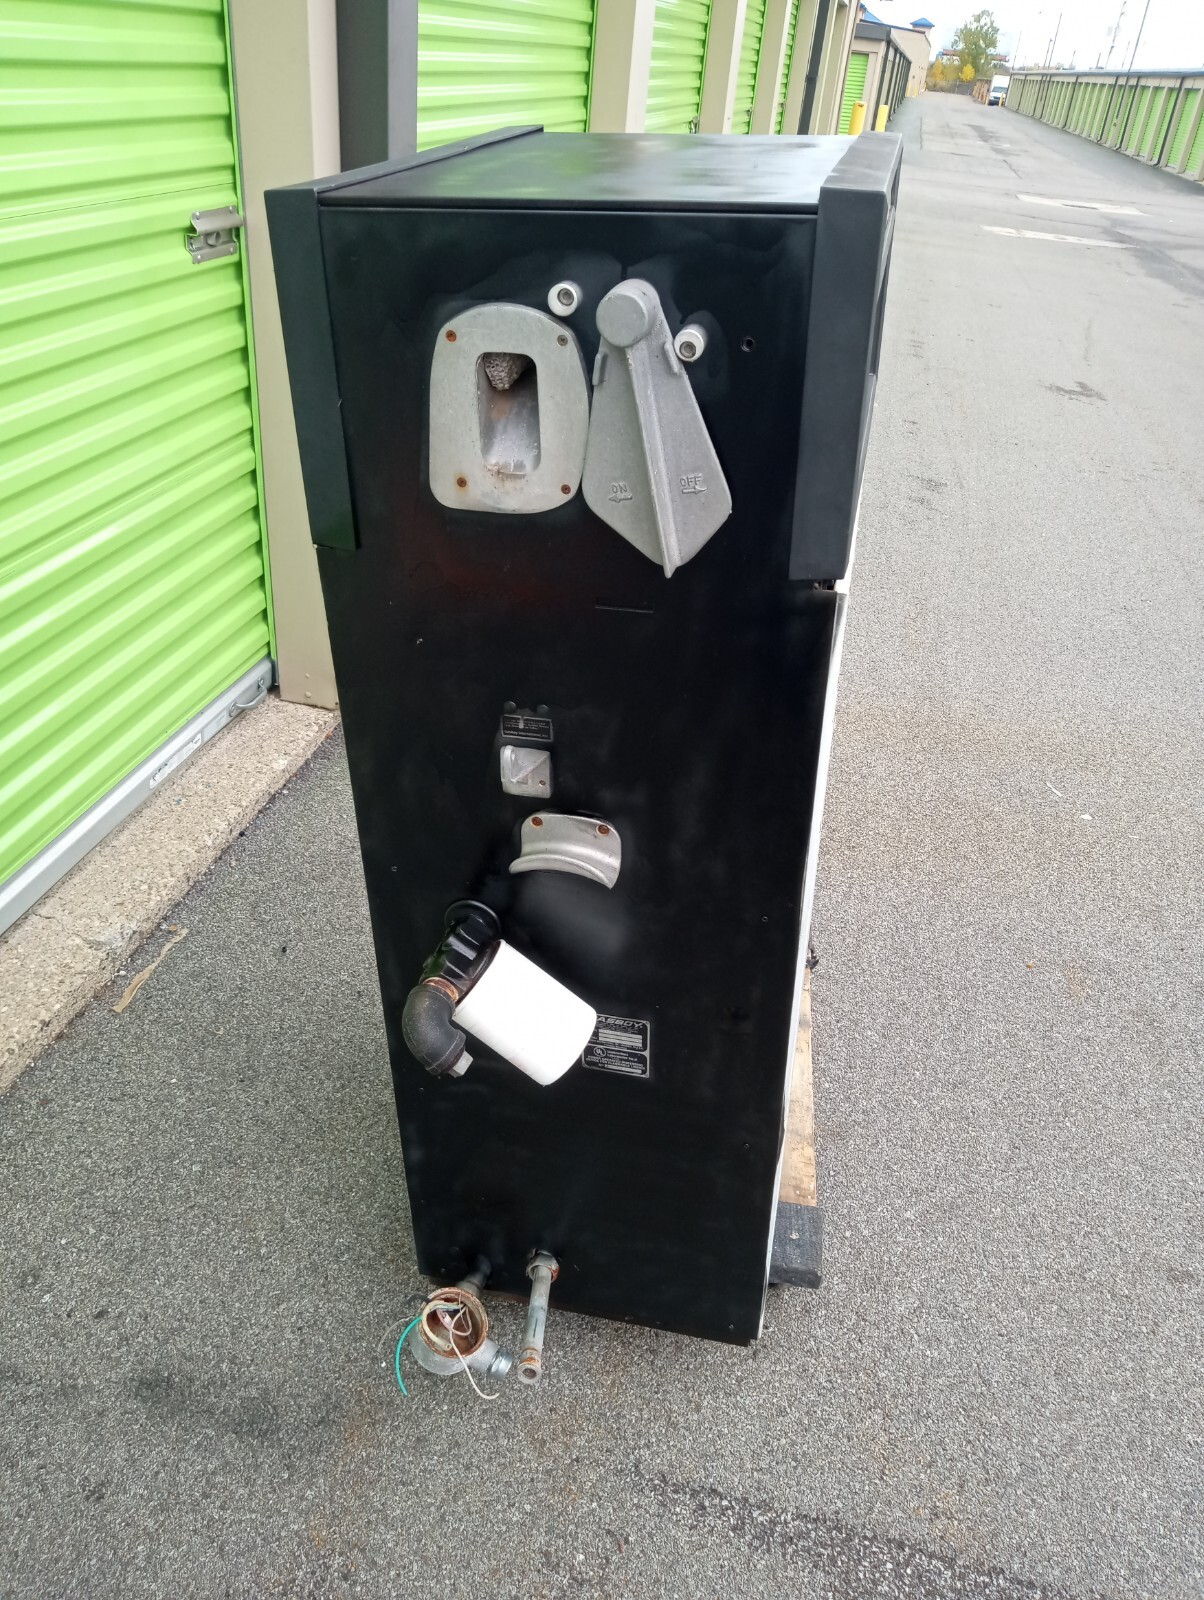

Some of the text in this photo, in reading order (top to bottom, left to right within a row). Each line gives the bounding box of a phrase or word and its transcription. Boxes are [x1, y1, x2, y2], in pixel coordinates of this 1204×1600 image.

[679, 474, 702, 487] OFF
[611, 483, 627, 494] ON
[598, 1017, 643, 1027] ASBOY
